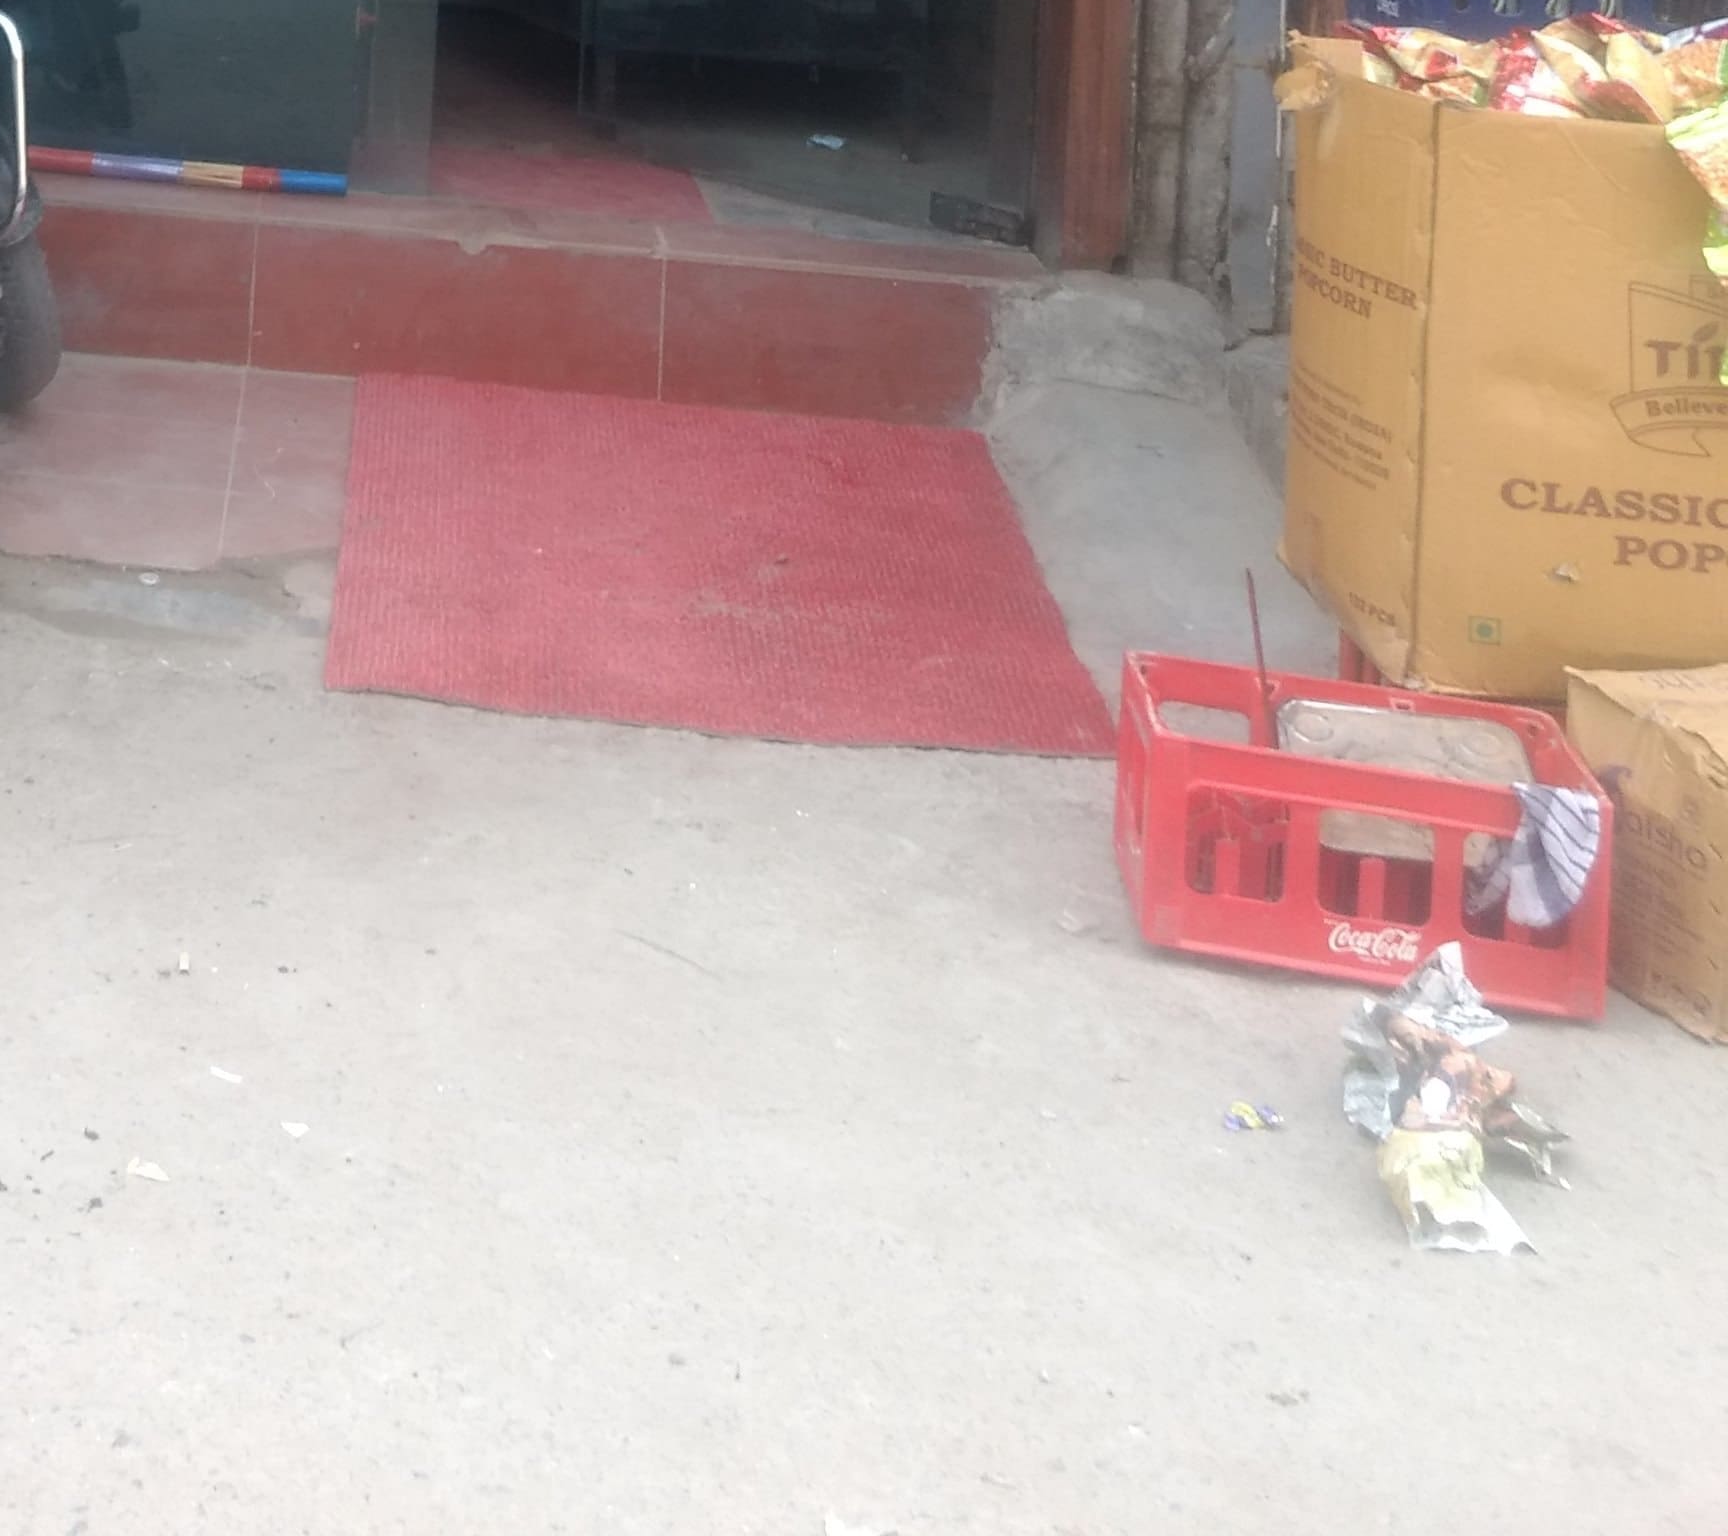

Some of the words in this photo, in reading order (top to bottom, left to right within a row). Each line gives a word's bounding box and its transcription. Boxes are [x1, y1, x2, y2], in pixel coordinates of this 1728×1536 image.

[1329, 256, 1418, 310] BUTTER
[1500, 476, 1728, 529] CLASSIC
[1613, 535, 1728, 574] POP
